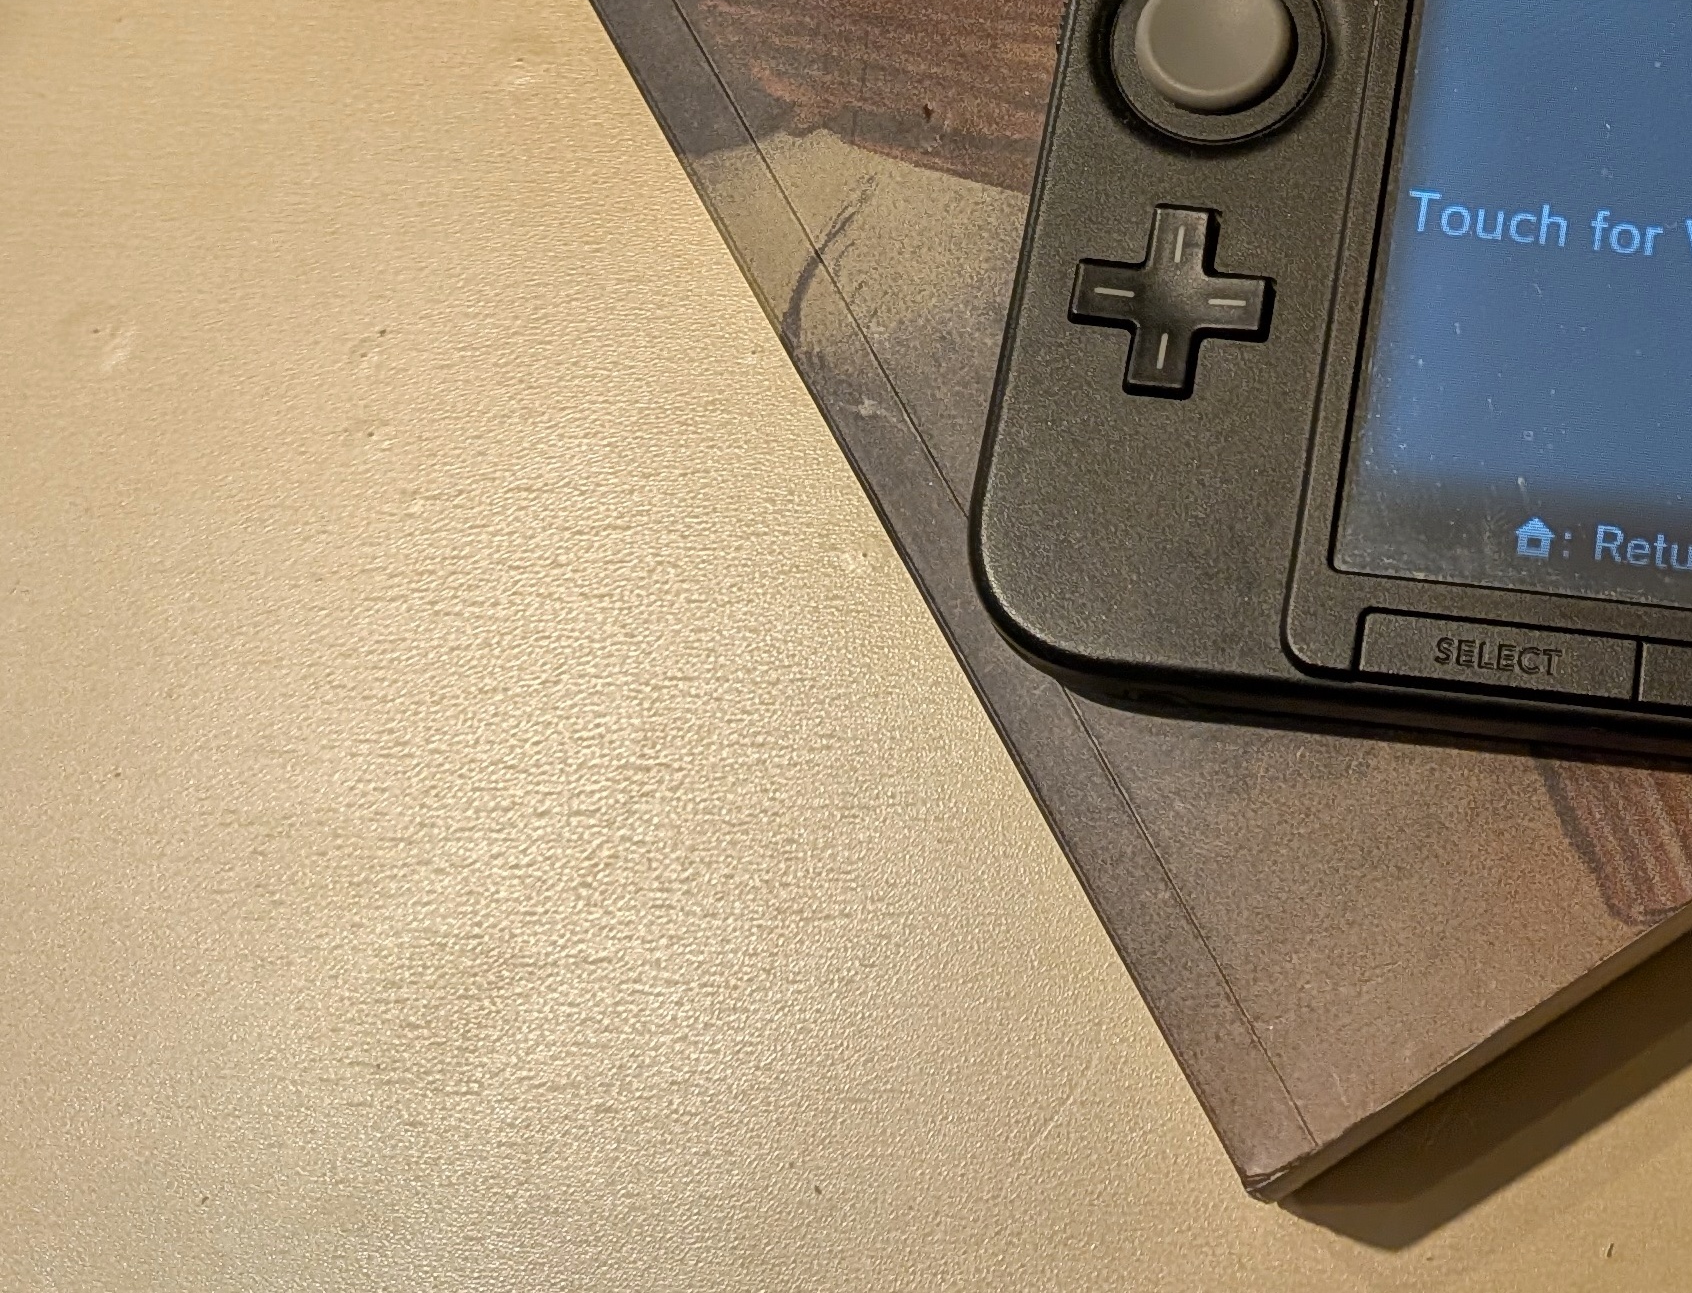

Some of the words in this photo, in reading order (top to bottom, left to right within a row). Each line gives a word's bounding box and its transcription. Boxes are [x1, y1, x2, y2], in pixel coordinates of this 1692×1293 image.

[1409, 189, 1568, 247] Touch
[1591, 209, 1663, 256] for
[1434, 637, 1562, 676] SELECT
